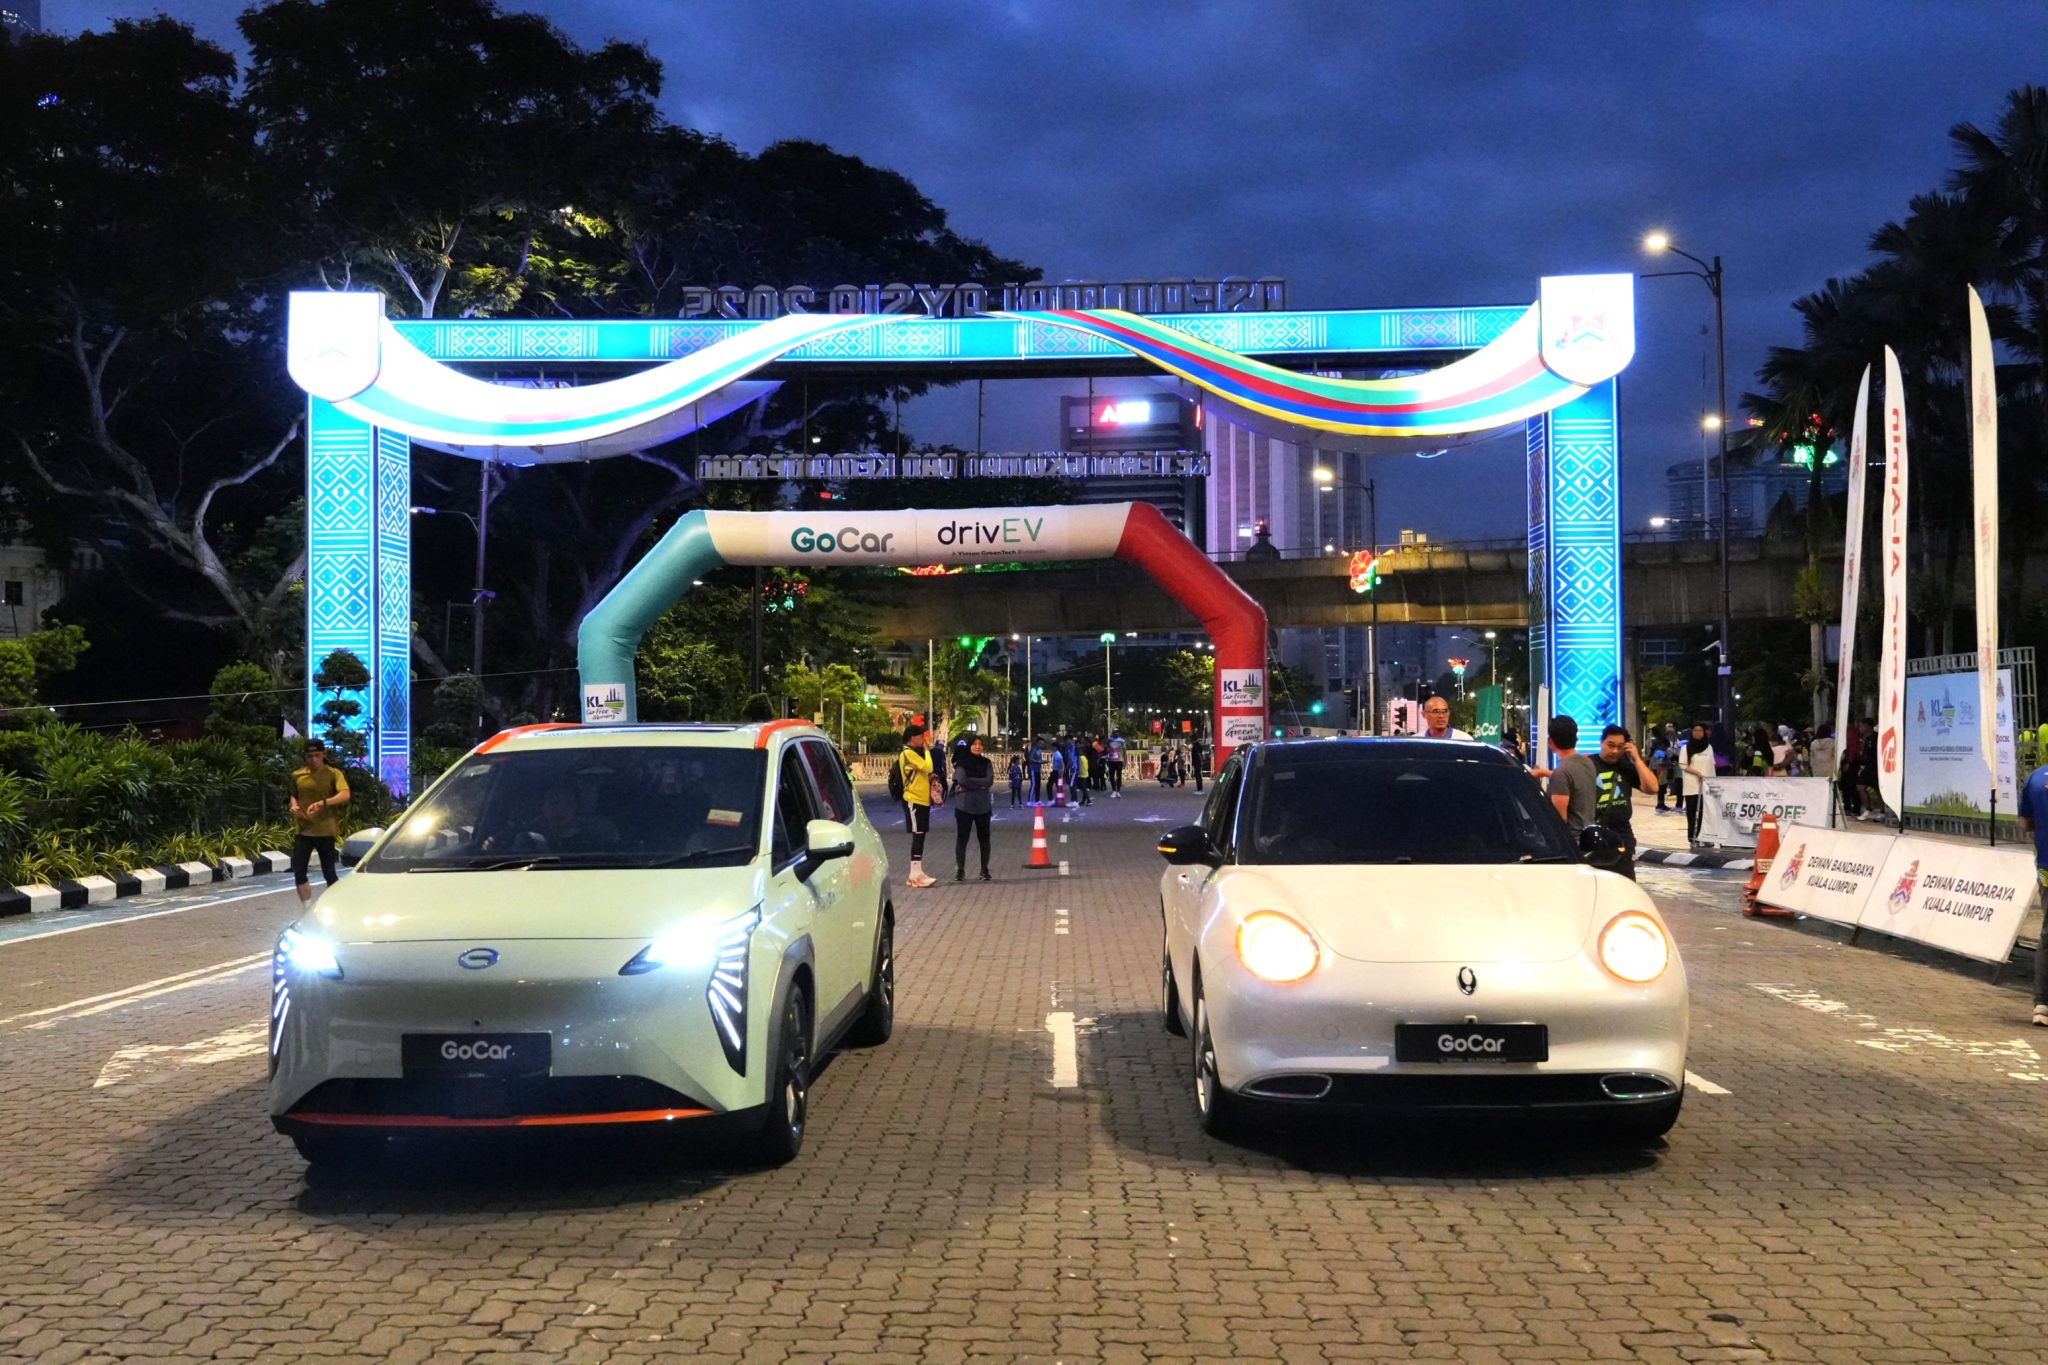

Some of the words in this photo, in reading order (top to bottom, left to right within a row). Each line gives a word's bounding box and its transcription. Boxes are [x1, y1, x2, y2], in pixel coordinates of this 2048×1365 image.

[791, 526, 894, 553] GoCar
[937, 517, 1044, 545] drivEV
[1223, 680, 1242, 692] KL
[586, 696, 603, 708] KL
[1725, 802, 1738, 810] GET
[1739, 803, 1767, 818] 50%
[1807, 856, 1833, 870] DEWAN
[1831, 859, 1875, 878] BANDARAYA
[1806, 875, 1829, 889] KUALA
[1827, 878, 1858, 895] LUMPUR
[1922, 874, 1956, 891] DEWAN
[1954, 879, 2015, 902] BANDARAYA
[1922, 896, 1953, 914] KUALA
[1951, 901, 1994, 922] LUMPUR
[440, 1040, 512, 1059] GoCar
[1437, 1034, 1505, 1052] GoCar
